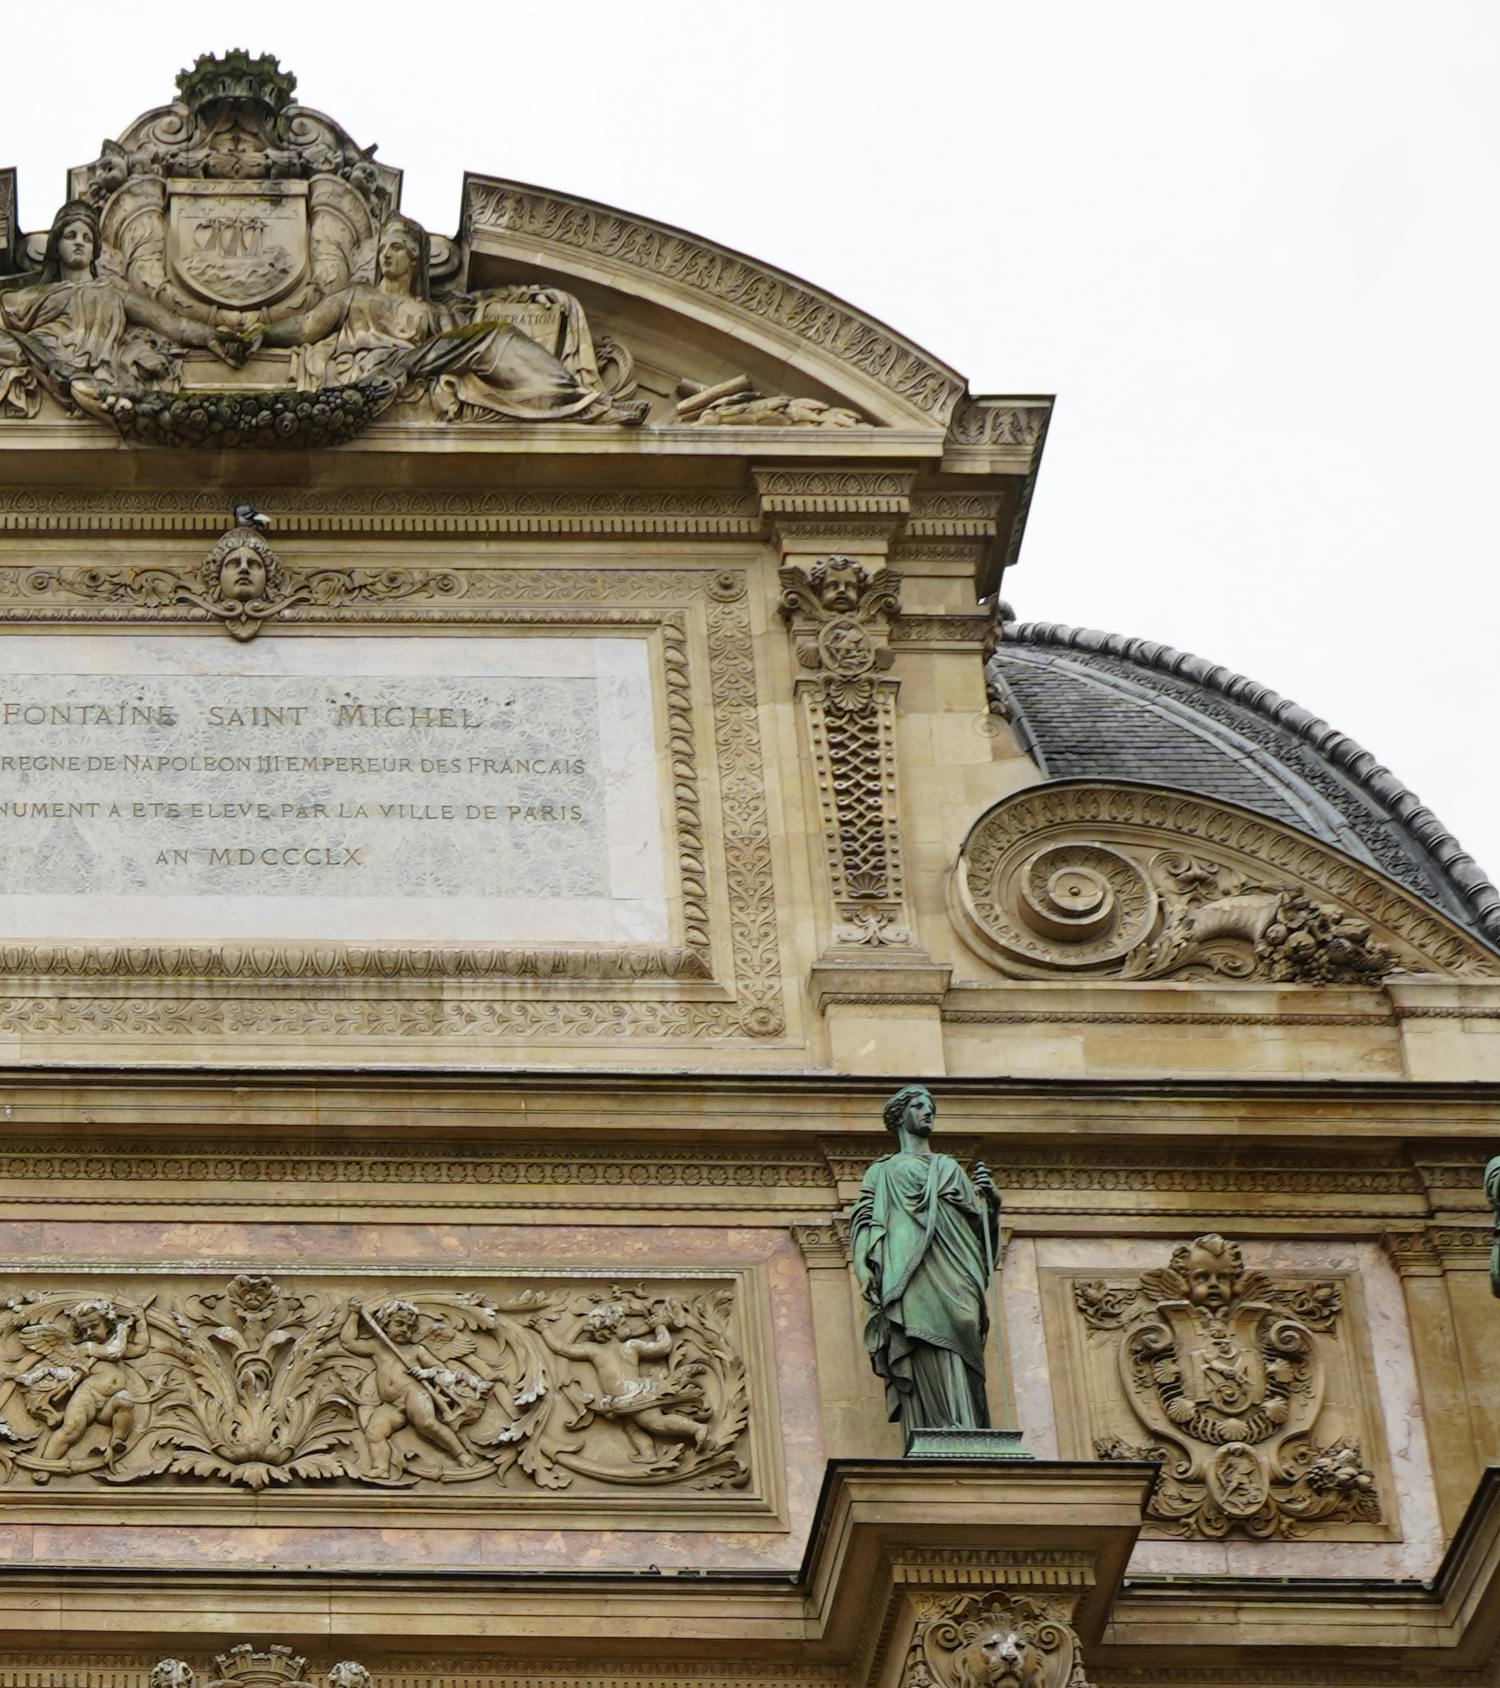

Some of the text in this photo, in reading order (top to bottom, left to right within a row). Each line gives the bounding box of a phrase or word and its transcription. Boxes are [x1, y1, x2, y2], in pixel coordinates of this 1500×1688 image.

[3, 702, 482, 728] FONTAINE SAINT MICHEL
[1, 755, 81, 771] REGNE
[88, 755, 115, 771] DE
[122, 754, 250, 772] NAPOLEON
[257, 755, 280, 772] III
[287, 756, 413, 773] EMPEREUR
[420, 758, 462, 774] DES
[468, 757, 586, 775] FRANCAIS
[108, 803, 121, 818] A
[132, 803, 180, 818] ETE
[190, 803, 270, 818] ELEVE
[281, 803, 330, 818] PAR
[339, 803, 369, 818] LA
[379, 804, 456, 820] VILLE
[466, 805, 497, 820] DE
[507, 805, 583, 820] PARIS
[155, 848, 363, 866] AN MDCCCLX
